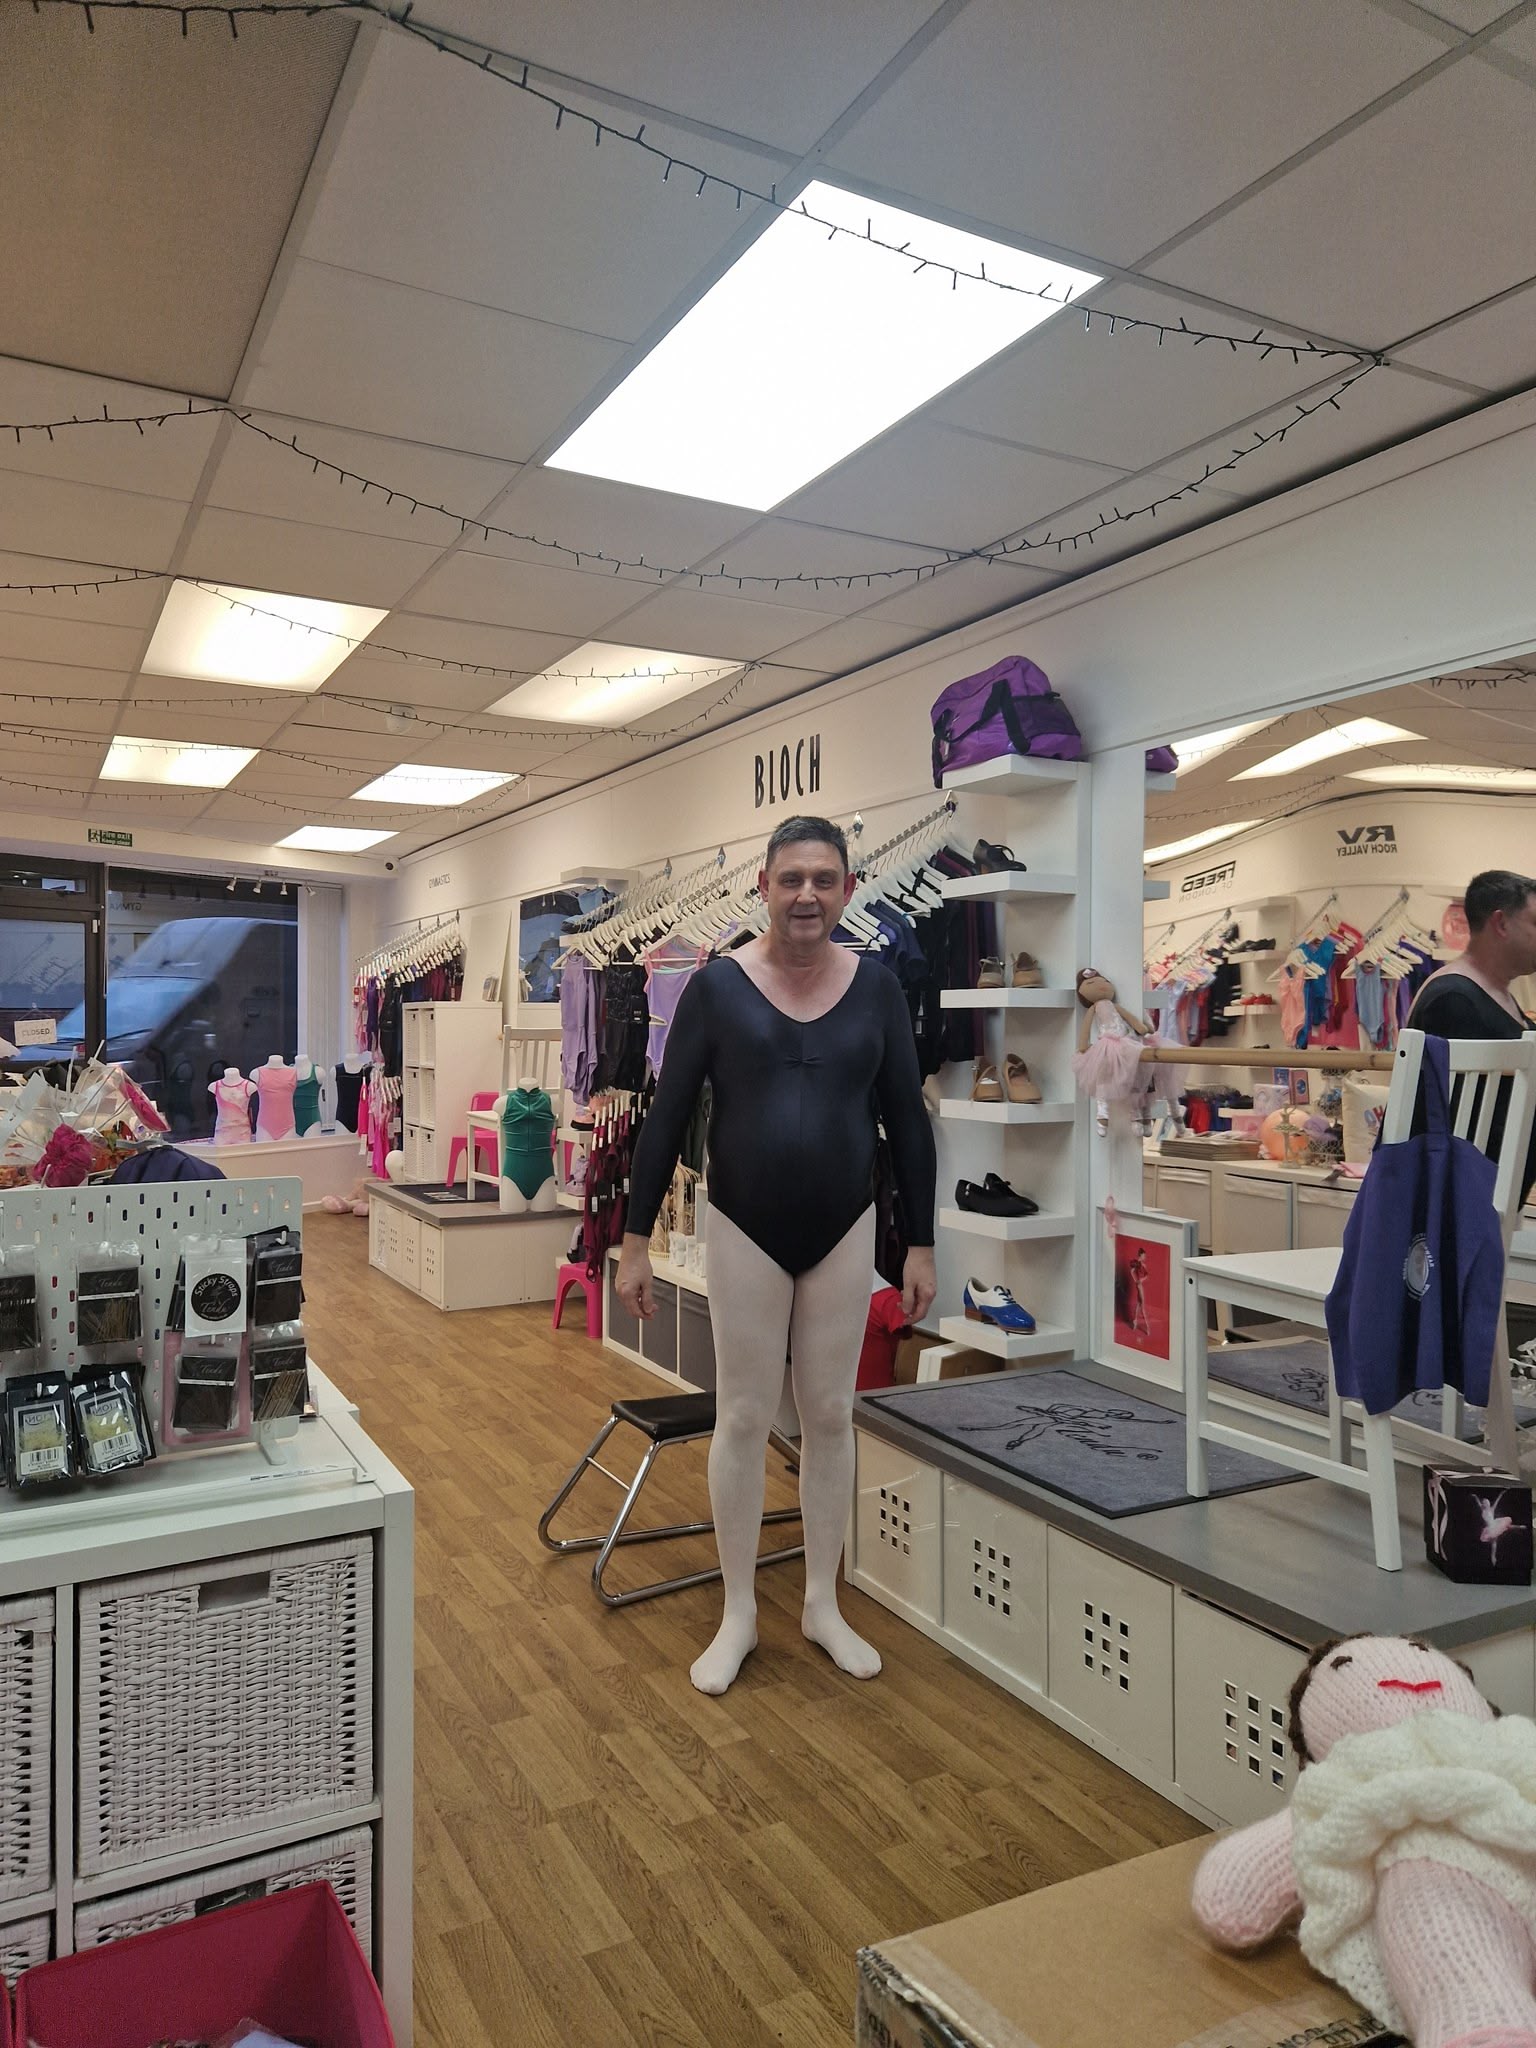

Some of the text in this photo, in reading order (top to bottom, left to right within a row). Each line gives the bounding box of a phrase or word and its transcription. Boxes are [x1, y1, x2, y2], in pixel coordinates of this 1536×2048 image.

[754, 733, 821, 809] BLOCH
[21, 1027, 51, 1037] CLOSED
[194, 1275, 238, 1297] Sticky Straps
